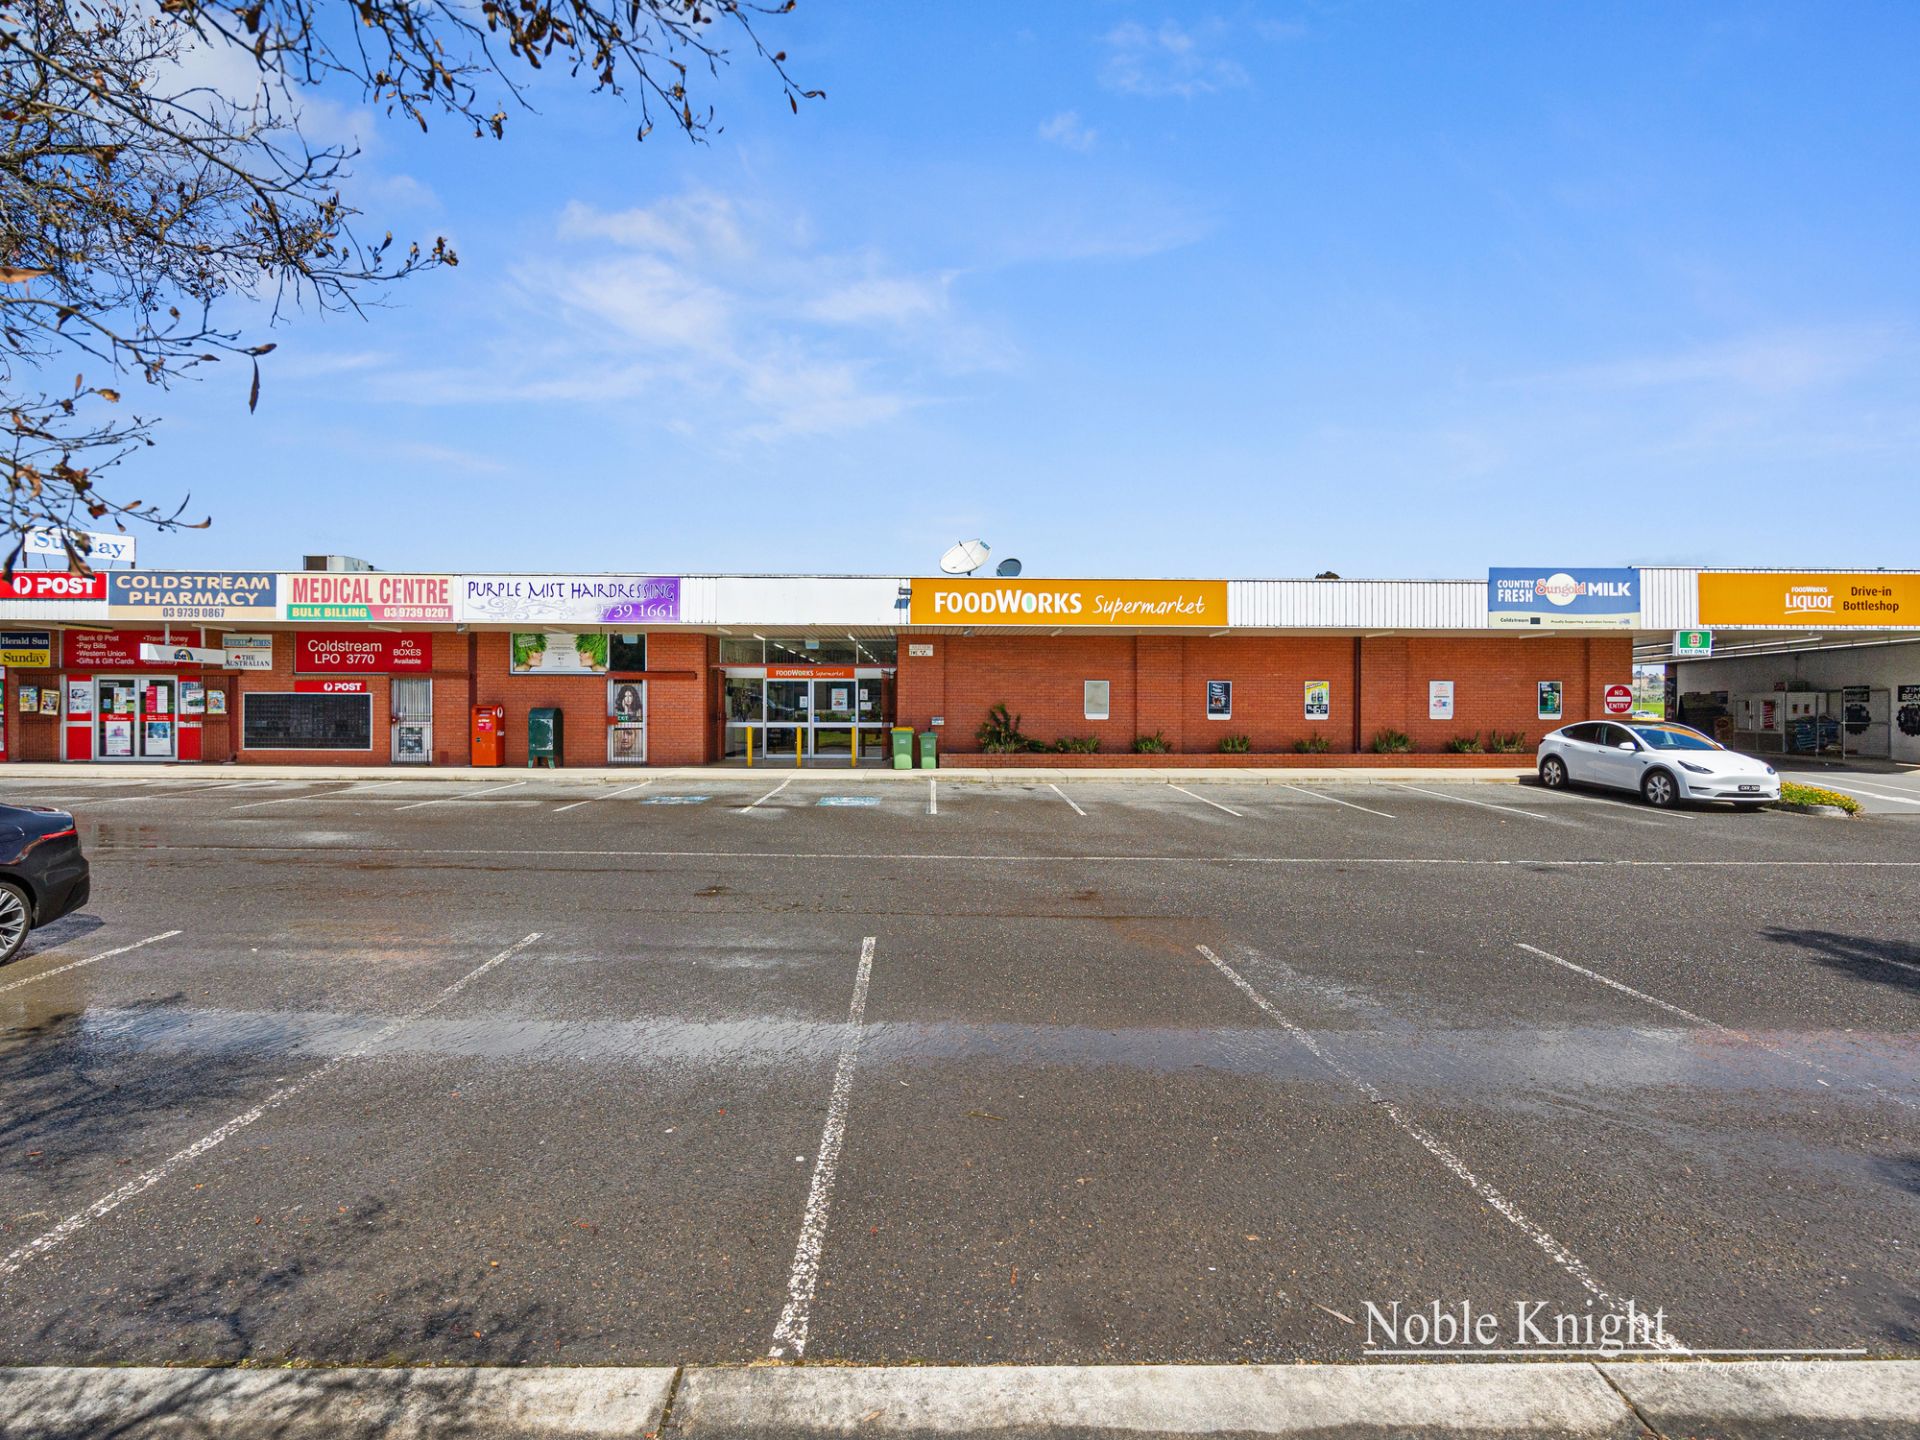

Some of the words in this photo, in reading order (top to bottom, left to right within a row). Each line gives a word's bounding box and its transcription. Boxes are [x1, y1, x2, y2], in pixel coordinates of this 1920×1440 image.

[37, 577, 96, 594] POST
[116, 575, 270, 590] COLDSTREAM
[1497, 580, 1535, 589] COUNTRY
[1535, 578, 1587, 597] Sungold
[1588, 582, 1632, 597] MILK
[293, 577, 374, 604] MEDICAL
[379, 578, 449, 604] CENTRE
[467, 580, 521, 599] PURPLE
[528, 582, 566, 599] MIST
[571, 582, 675, 601] HAIRDRESSING
[1498, 589, 1533, 602] FRESH
[1851, 586, 1892, 597] Drive-in
[128, 591, 259, 605] PHARMACY
[1785, 593, 1834, 611] Liquor
[163, 607, 175, 618] 03
[177, 607, 200, 618] 9739
[202, 607, 225, 618] 0867
[292, 607, 321, 617] BULK
[324, 607, 367, 618] BILLING
[383, 607, 397, 618] 03
[399, 607, 423, 618] 9739
[425, 607, 449, 618] 0201
[639, 604, 674, 618] 1661
[934, 589, 1083, 614] FOODWORKS
[1092, 595, 1206, 623] Supermarket
[1843, 600, 1900, 613] Bottleshop
[2, 636, 29, 645] Herald
[32, 636, 49, 645] Sun
[307, 639, 383, 652] Coldstream
[401, 640, 413, 648] PO
[3, 651, 46, 665] Sunday
[225, 659, 270, 667] AUSTRALIAN
[315, 653, 340, 664] LPO
[346, 653, 375, 664] 3770
[334, 682, 362, 691] POST
